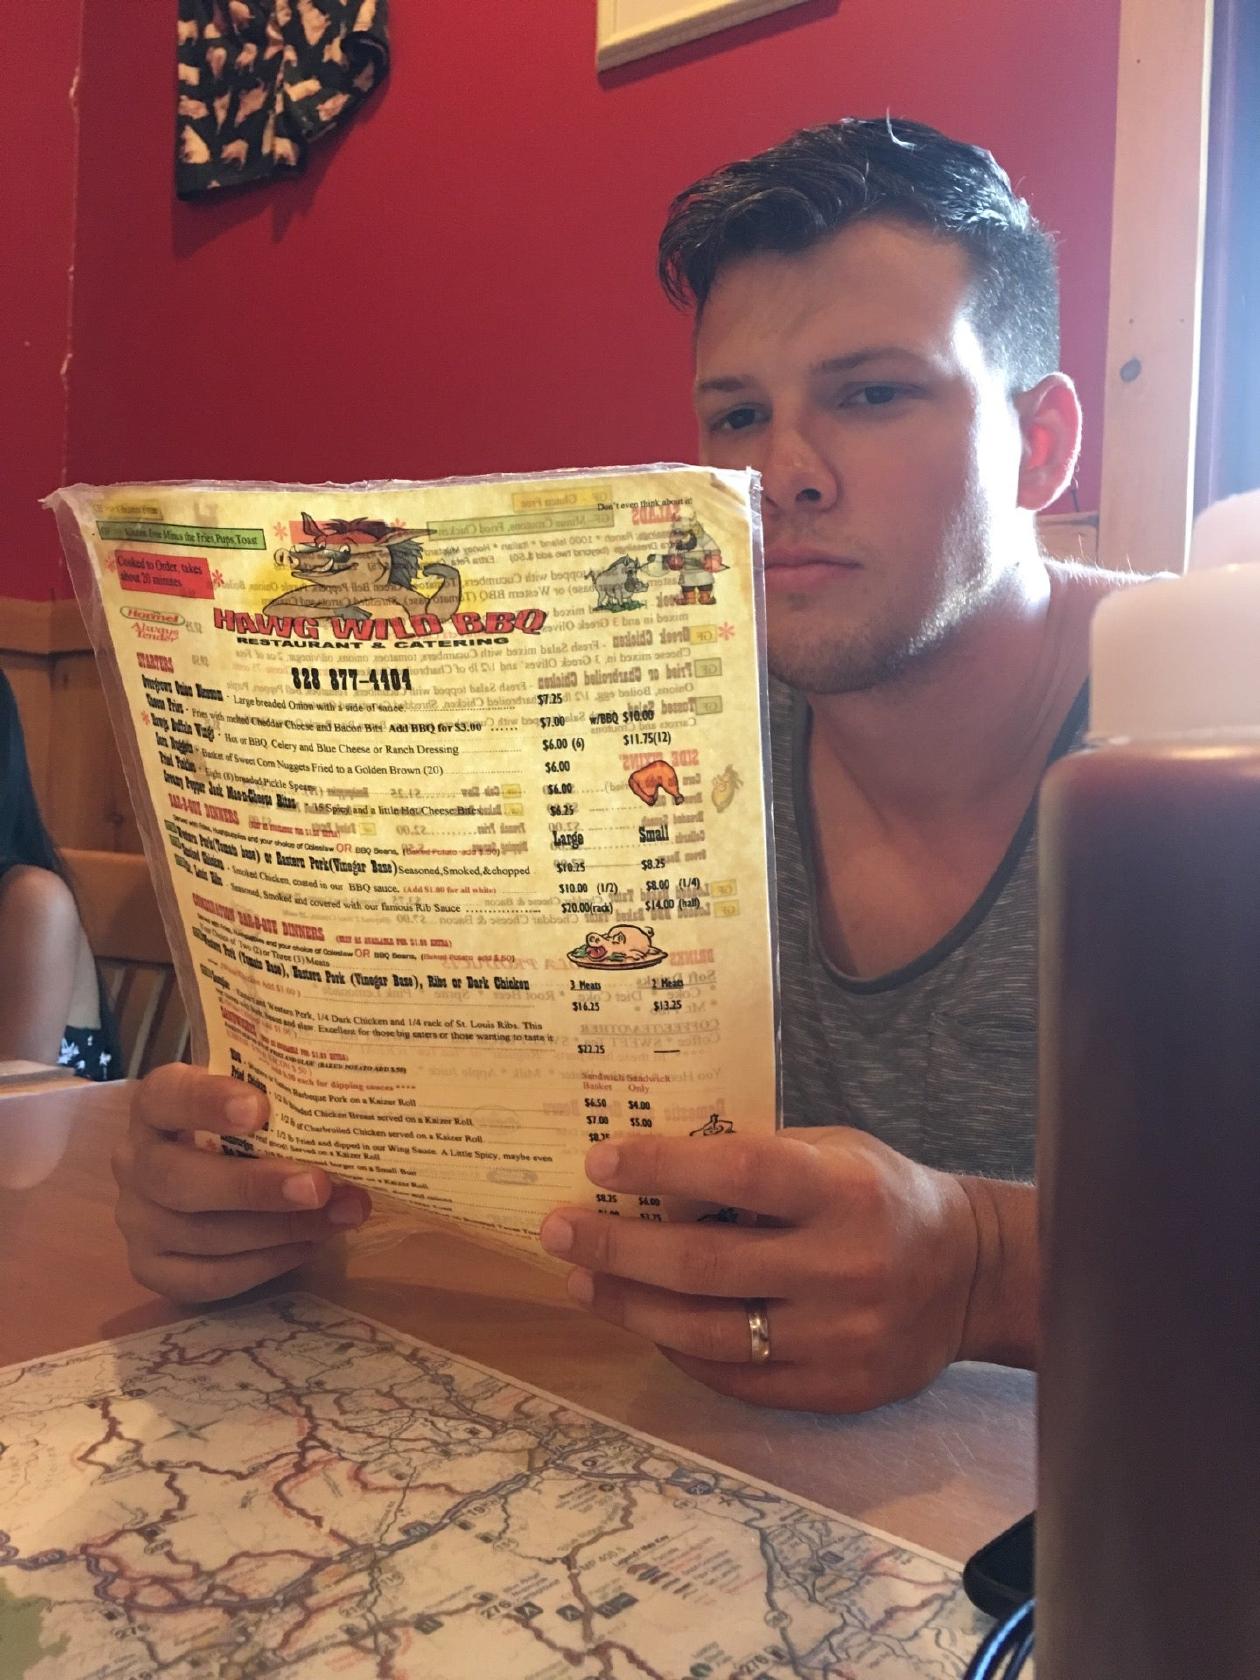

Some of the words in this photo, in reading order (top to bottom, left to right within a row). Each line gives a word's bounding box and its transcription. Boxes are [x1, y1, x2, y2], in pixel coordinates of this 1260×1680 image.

[597, 502, 620, 511] Don't
[185, 531, 195, 541] the
[118, 556, 145, 569] Cooked
[181, 563, 202, 574] takes
[121, 572, 139, 583] about
[142, 573, 151, 584] 20
[128, 609, 179, 623] Hormel
[213, 608, 319, 639] HAWG
[331, 613, 443, 640] WILD
[451, 609, 547, 635] BBQ
[132, 623, 179, 635] Always
[137, 631, 178, 642] Tender
[237, 637, 363, 649] RESTAURANT
[394, 637, 509, 648] CATERING
[137, 652, 174, 673] STARTERS
[291, 667, 320, 690] 828
[329, 668, 411, 690] 877-4404
[234, 695, 255, 706] Large
[256, 697, 285, 709] breaded
[289, 701, 314, 711] Onion
[316, 703, 335, 711] with
[345, 704, 363, 712] side
[366, 703, 376, 712] of
[537, 693, 562, 706] $7.25
[192, 709, 208, 718] Fries
[210, 711, 224, 721] with
[227, 714, 249, 725] melted
[251, 717, 283, 728] Cheddar
[284, 720, 314, 731] Cheese
[316, 723, 332, 731] and
[334, 723, 361, 732] Bacon
[389, 724, 408, 732] Add
[412, 724, 435, 733] BBQ
[438, 723, 453, 731] for
[455, 722, 481, 731] $3.00
[540, 716, 565, 729] $7.00
[590, 711, 618, 725] w/BBQ
[623, 710, 654, 723] $10.00
[225, 733, 238, 743] Hot
[271, 740, 296, 752] Celery
[299, 742, 314, 752] and
[317, 743, 336, 753] Blue
[339, 745, 371, 753] Cheese
[386, 745, 414, 753] Ranch
[417, 745, 459, 755] Dressing
[543, 739, 567, 751] $6.00
[572, 738, 585, 751] (6)
[202, 748, 223, 759] Basket
[234, 755, 255, 765] Sweet
[257, 758, 275, 768] Corn
[277, 757, 309, 772] Nuggets
[312, 762, 333, 773] Fried
[336, 764, 345, 774] to
[355, 765, 387, 774] Golden
[389, 766, 421, 775] Brown
[423, 766, 444, 776] (20)
[545, 761, 570, 773] $6.00
[264, 778, 286, 788] Pickle
[547, 783, 572, 795] $6.00
[353, 806, 368, 814] and
[378, 806, 398, 815] little
[421, 806, 455, 816] Cheese
[550, 804, 574, 816] $6.25
[553, 830, 584, 849] Large
[639, 825, 669, 843] Small
[336, 843, 352, 853] OR
[276, 852, 305, 868] Eastern
[556, 862, 585, 873] $10.25
[641, 858, 665, 871] $8.25
[292, 878, 318, 888] coated
[349, 883, 371, 892] BBQ
[559, 883, 588, 894] $10.00
[597, 883, 618, 894] (1/2)
[646, 879, 669, 891] $8.00
[679, 878, 700, 890] (1/4)
[263, 890, 292, 904] Smoked
[294, 897, 308, 906] and
[310, 899, 341, 909] covered
[343, 901, 361, 910] with
[382, 903, 413, 912] famous
[416, 904, 431, 912] Rib
[435, 904, 460, 913] Sauce
[645, 899, 674, 911] $14.00
[282, 922, 325, 941] DINNERS
[354, 948, 370, 958] OR
[293, 954, 304, 964] (3)
[306, 957, 330, 967] Meats
[580, 981, 601, 990] Meats
[661, 979, 683, 989] Meats
[293, 966, 322, 982] Eastern
[325, 971, 345, 984] Pork
[350, 973, 387, 989] (Vinegar
[392, 975, 423, 989] Base),
[428, 975, 447, 988] Ribs
[452, 978, 461, 988] or
[467, 976, 489, 989] Dark
[494, 977, 530, 990] Chicken
[572, 1002, 599, 1012] $16.25
[654, 1001, 682, 1011] $13.25
[331, 1015, 351, 1024] Dark
[354, 1016, 388, 1025] Chicken
[358, 1027, 370, 1035] for
[396, 1029, 410, 1039] big
[451, 1032, 473, 1040] those
[477, 1033, 510, 1042] wanting
[524, 1034, 544, 1042] taste
[577, 1044, 605, 1054] $22.25
[582, 1072, 625, 1083] Sandwich
[627, 1073, 670, 1083] Sandwich
[583, 1083, 612, 1091] Basket
[628, 1084, 649, 1094] Only
[398, 1096, 416, 1106] Roll
[585, 1098, 606, 1107] $6.50
[628, 1101, 650, 1110] $4.00
[586, 1116, 608, 1124] $7.00
[630, 1118, 652, 1127] $5.00
[388, 1144, 410, 1155] Wing
[450, 1149, 472, 1158] Little
[503, 1153, 530, 1162] maybe
[639, 1196, 660, 1206] $6.00
[480, 1599, 512, 1619] 276
